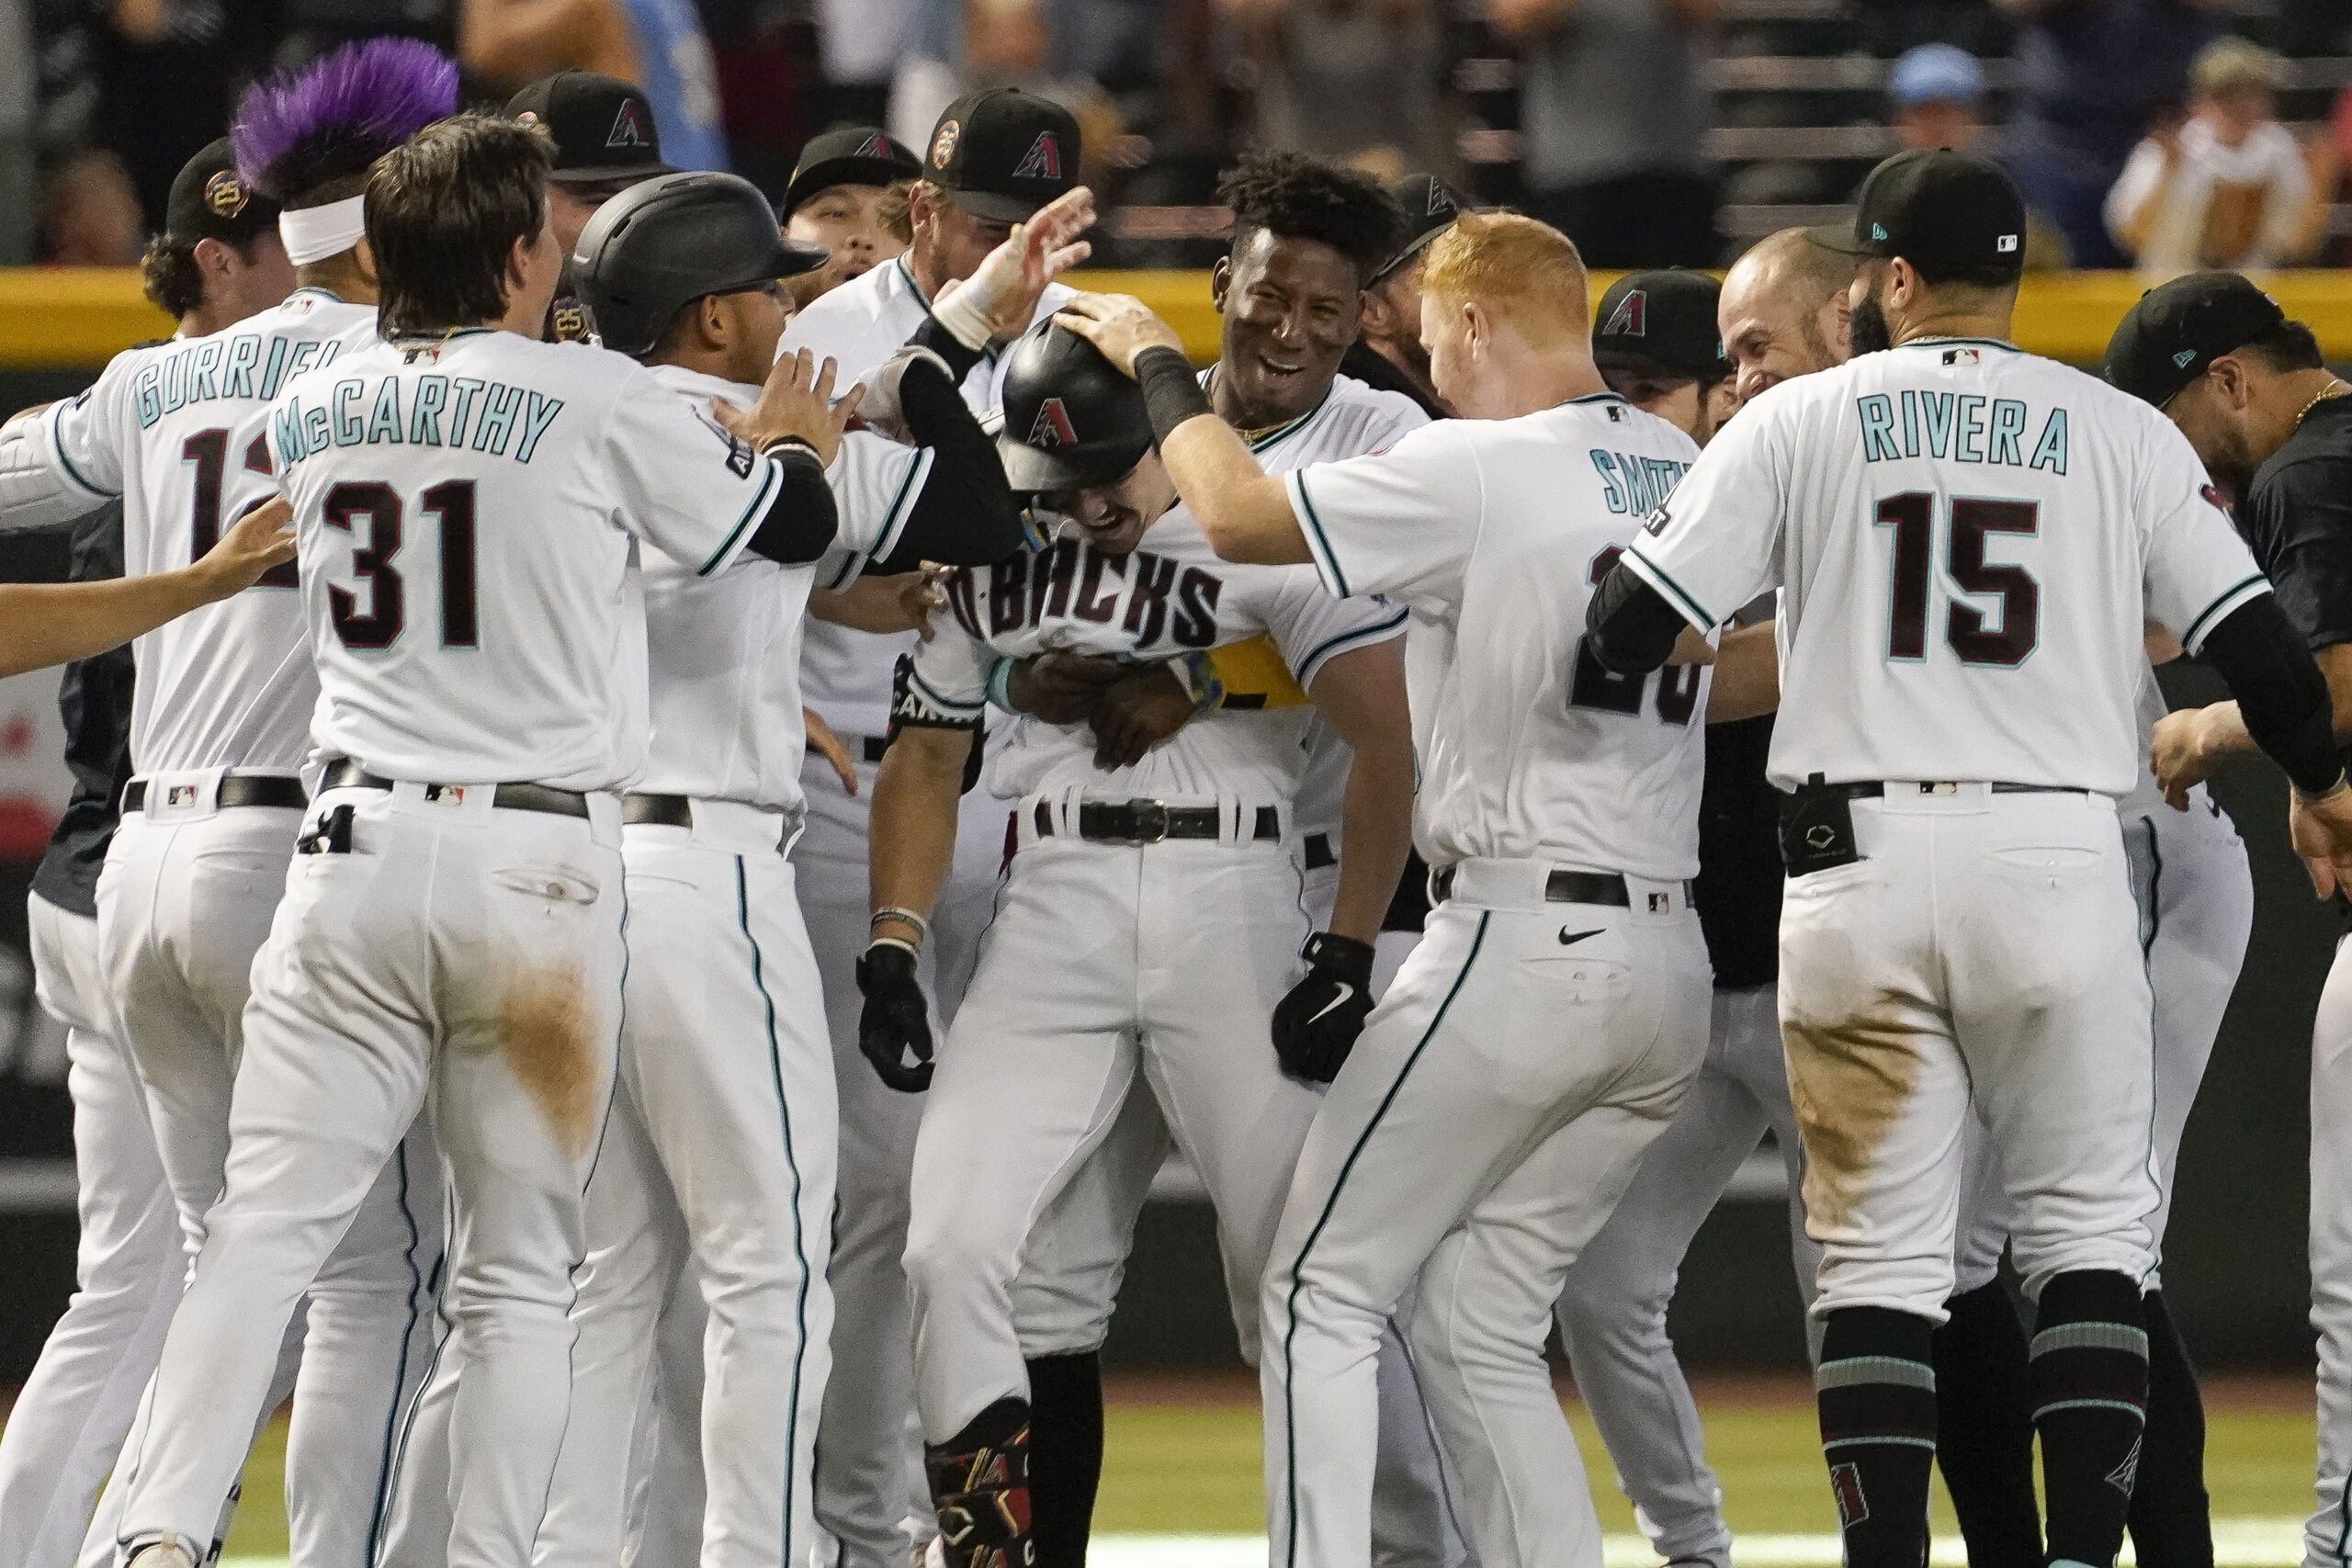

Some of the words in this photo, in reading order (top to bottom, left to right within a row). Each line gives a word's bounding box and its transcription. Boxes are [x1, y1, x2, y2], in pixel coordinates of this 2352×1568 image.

[212, 180, 241, 207] 25
[554, 307, 582, 332] 25
[277, 375, 565, 472] McCARTHY
[1857, 389, 2069, 476] RIVERA
[322, 478, 481, 652] 31
[1871, 491, 2041, 671] 15
